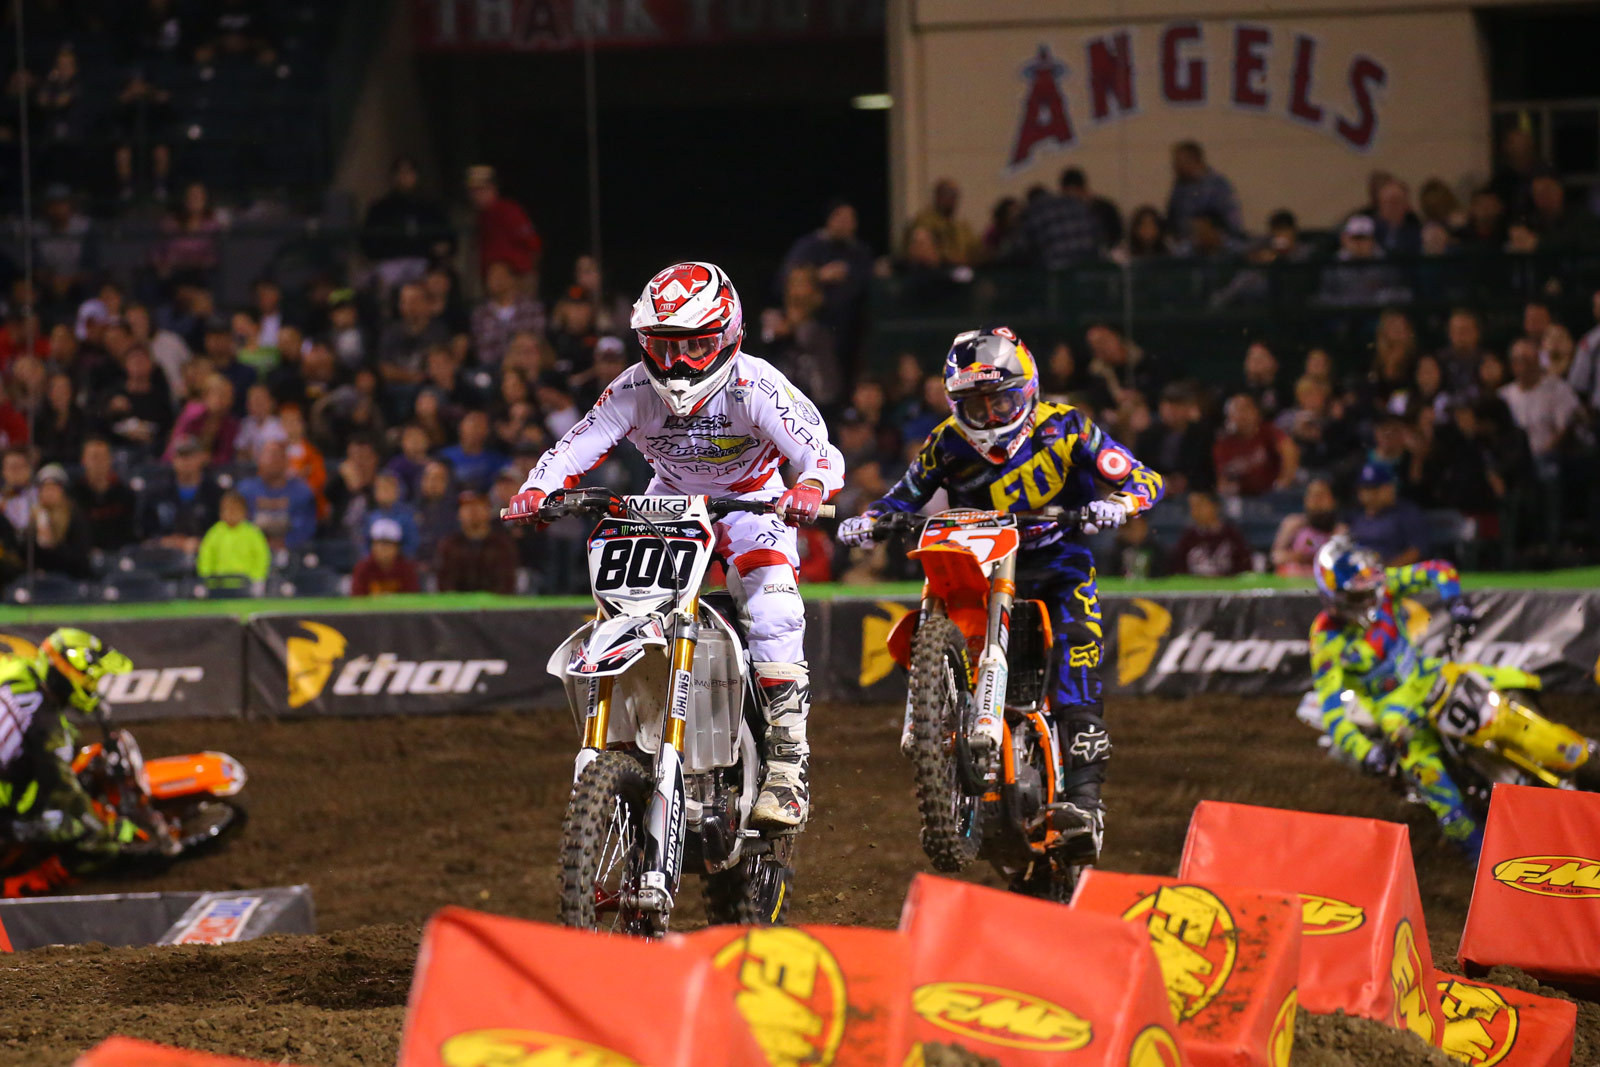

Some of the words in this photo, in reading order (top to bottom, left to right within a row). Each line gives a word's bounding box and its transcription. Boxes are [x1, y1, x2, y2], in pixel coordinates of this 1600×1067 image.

[1005, 22, 1388, 171] ANGELS
[629, 498, 687, 514] Mika
[595, 538, 698, 591] 800
[1156, 629, 1309, 673] thor
[332, 652, 508, 695] thor
[672, 673, 690, 717] ÖHLINS
[666, 789, 681, 877] DUNLOP
[1493, 861, 1600, 890] FM
[913, 988, 1092, 1041] FMF
